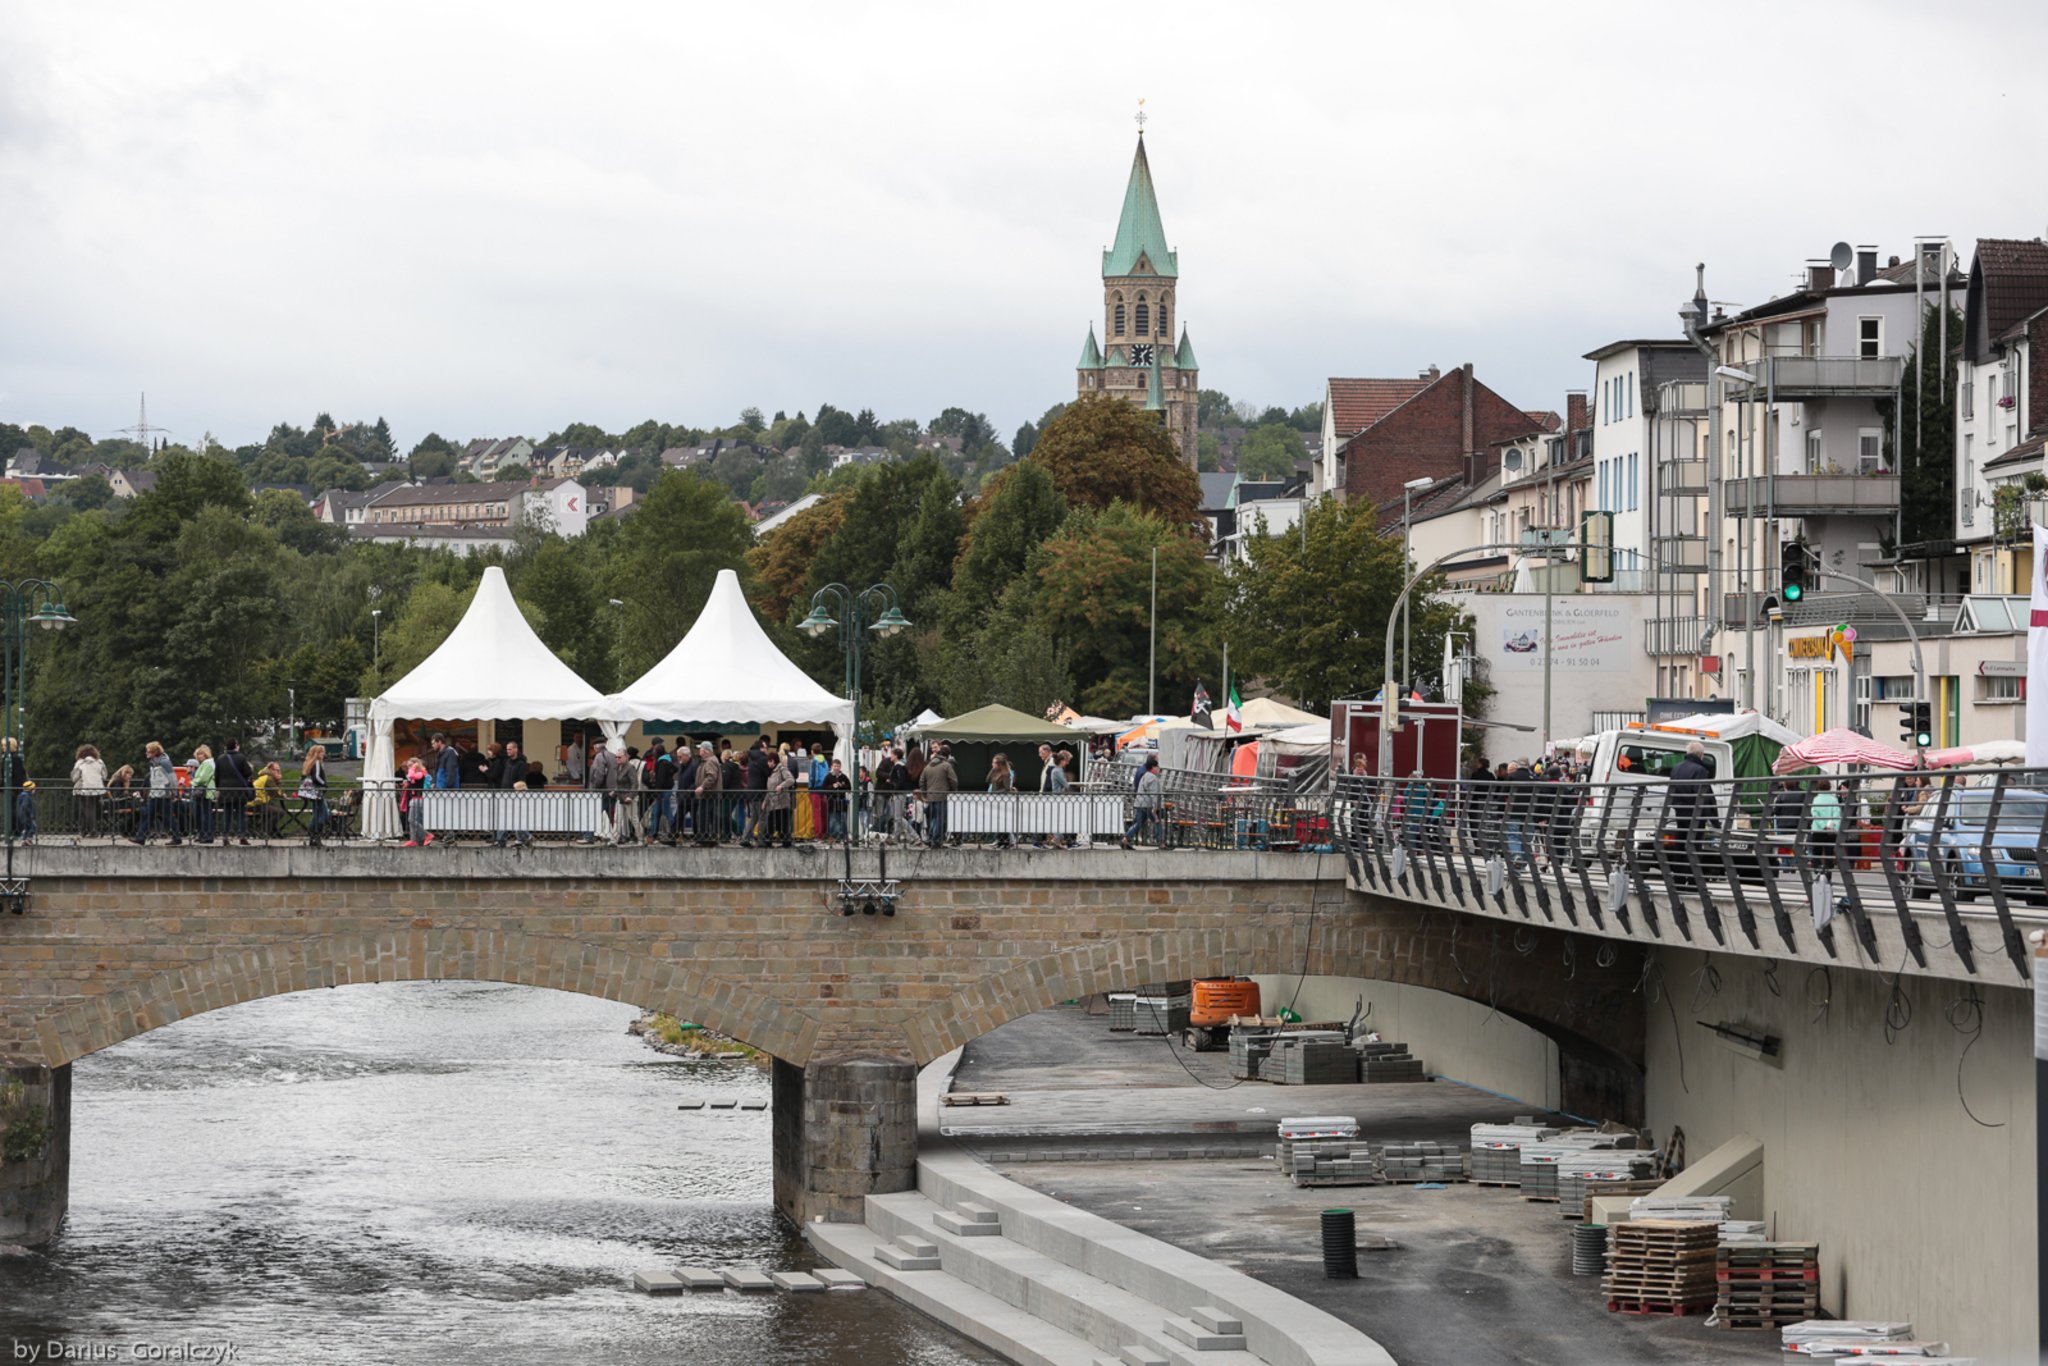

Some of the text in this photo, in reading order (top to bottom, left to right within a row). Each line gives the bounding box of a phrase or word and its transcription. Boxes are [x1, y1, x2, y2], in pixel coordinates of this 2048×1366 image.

[1506, 608, 1620, 617] GANTENBNK & GLOERFELD
[1529, 658, 1536, 666] 0
[1567, 658, 1576, 666] 91
[1578, 658, 1589, 666] 50
[1590, 658, 1600, 666] 04
